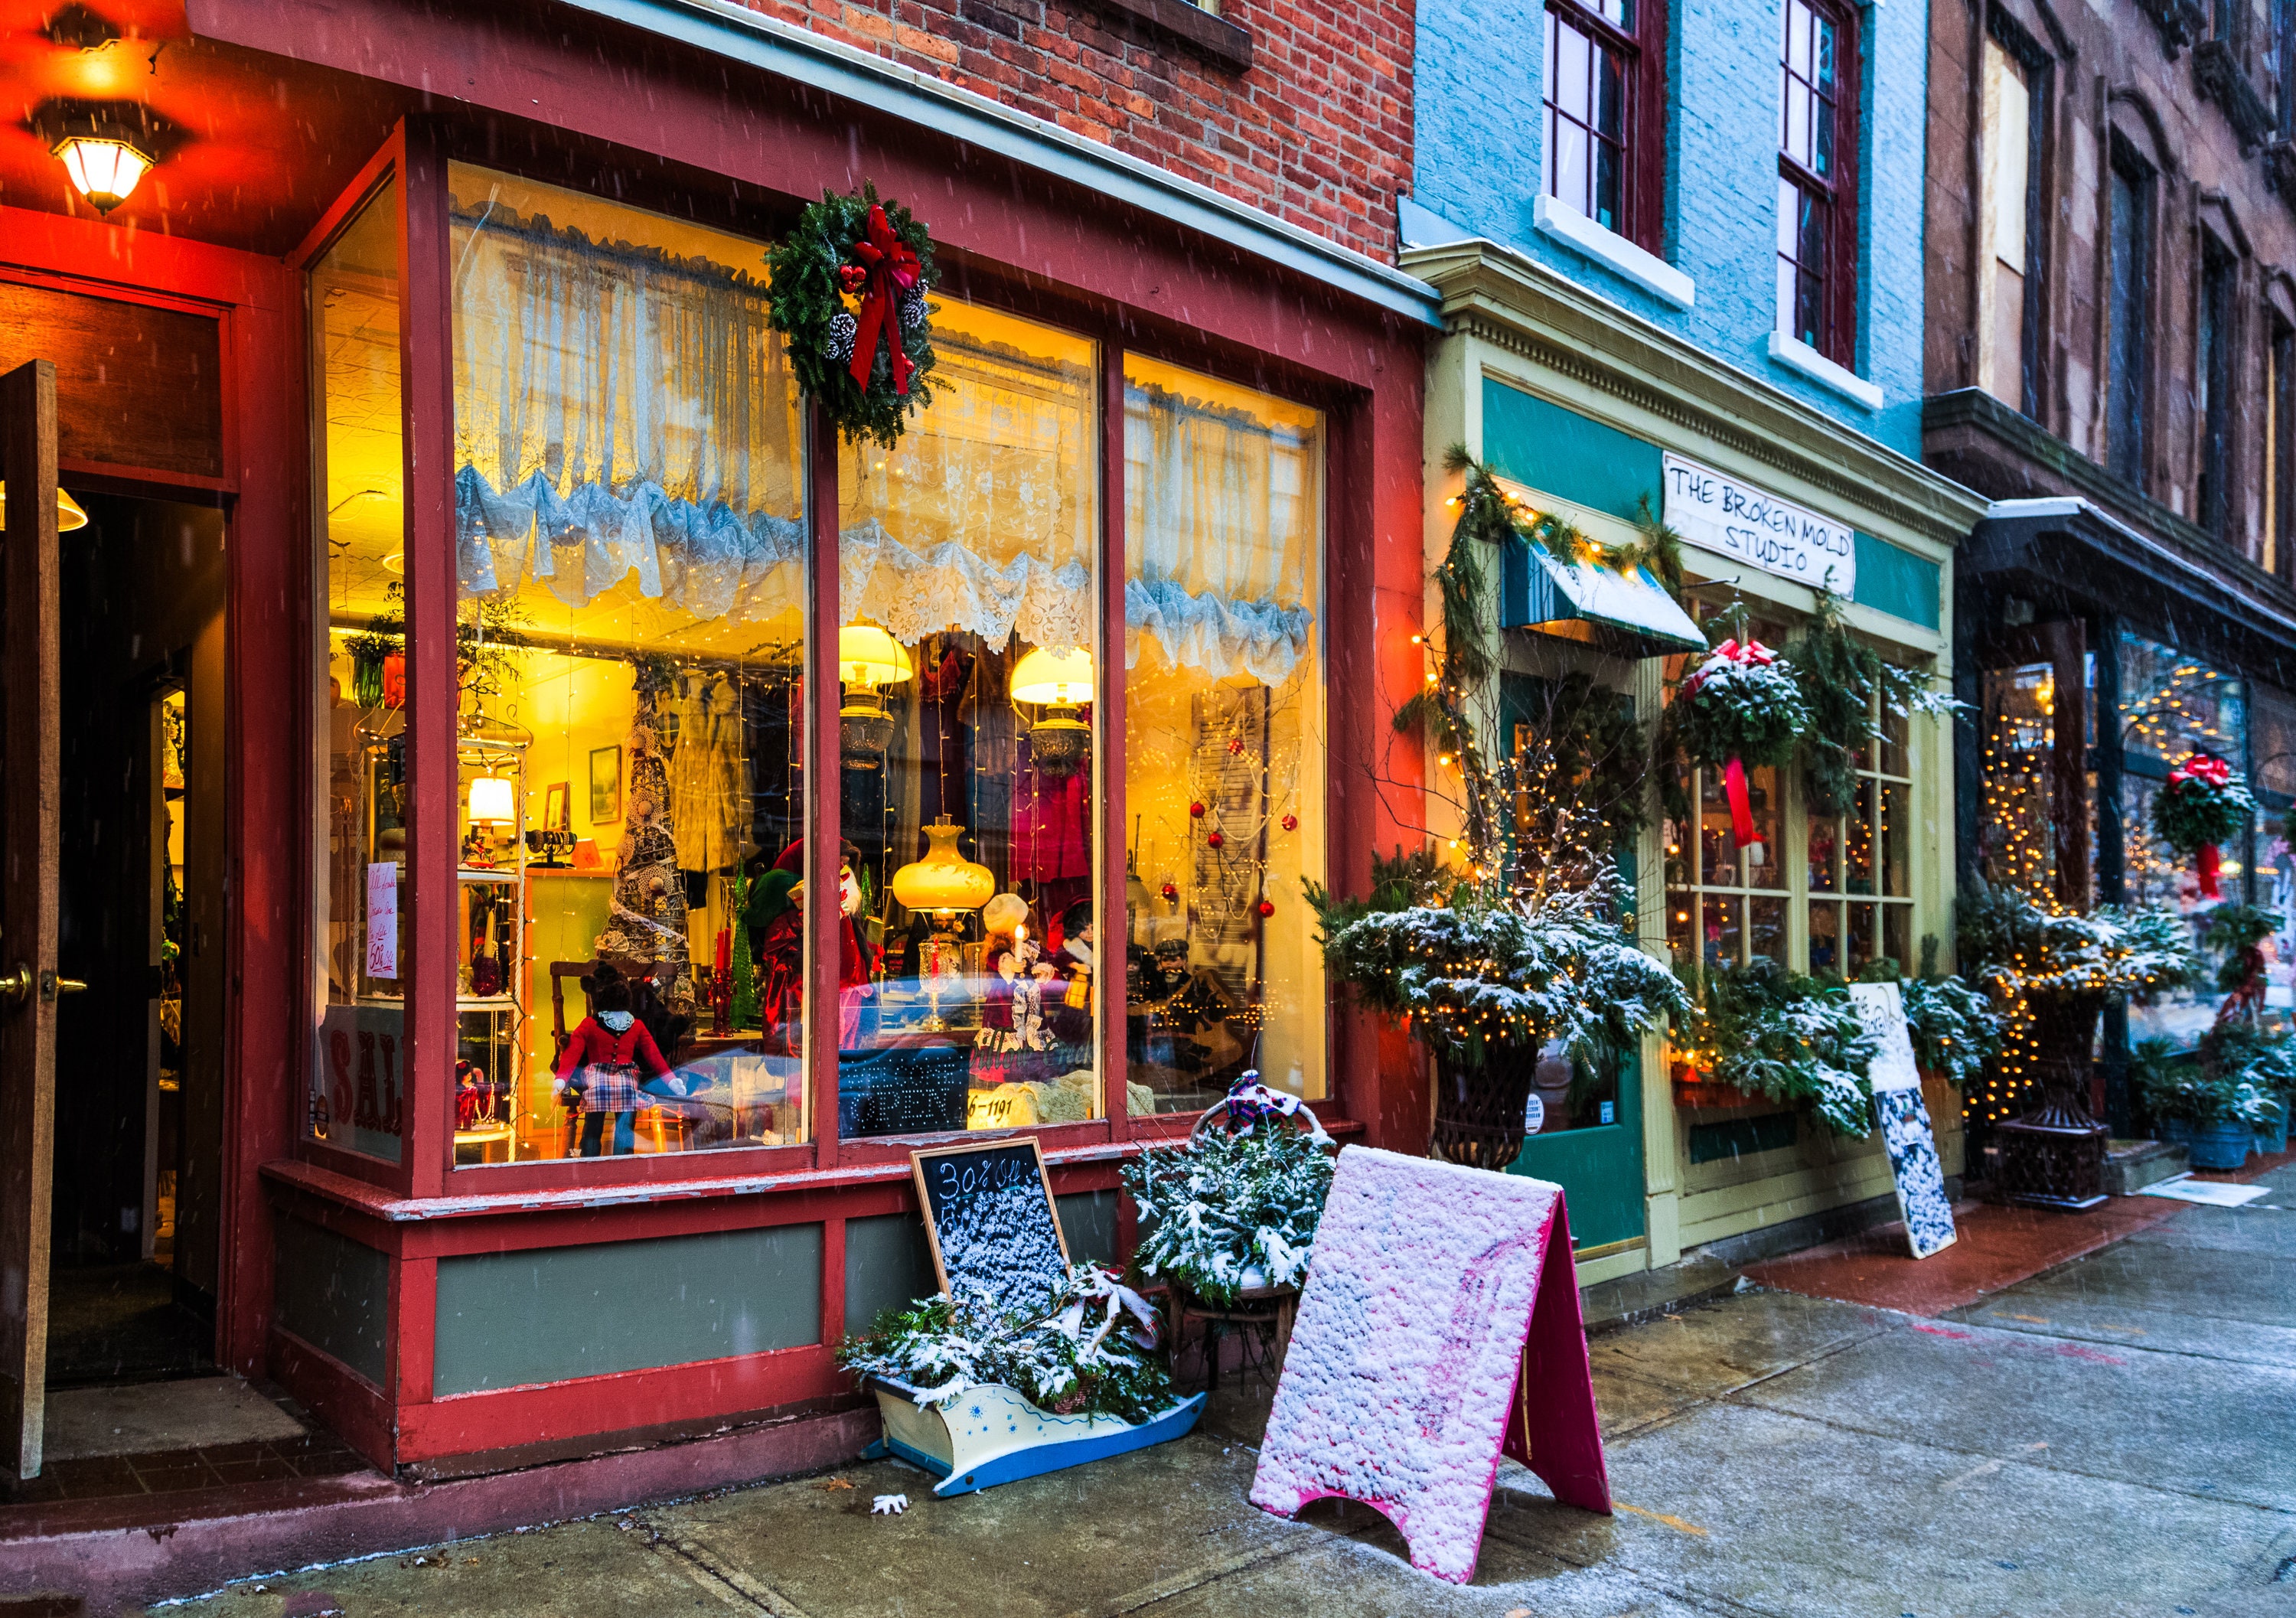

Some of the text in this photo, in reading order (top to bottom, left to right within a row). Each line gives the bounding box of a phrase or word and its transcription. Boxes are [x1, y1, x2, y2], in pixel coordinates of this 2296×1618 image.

[1669, 468, 1850, 556] THE BROKEN MOLD
[1725, 526, 1808, 571] STUDIO
[330, 1029, 403, 1137] SAL
[850, 1088, 951, 1123] OPEN
[968, 1094, 1014, 1123] 6-1191
